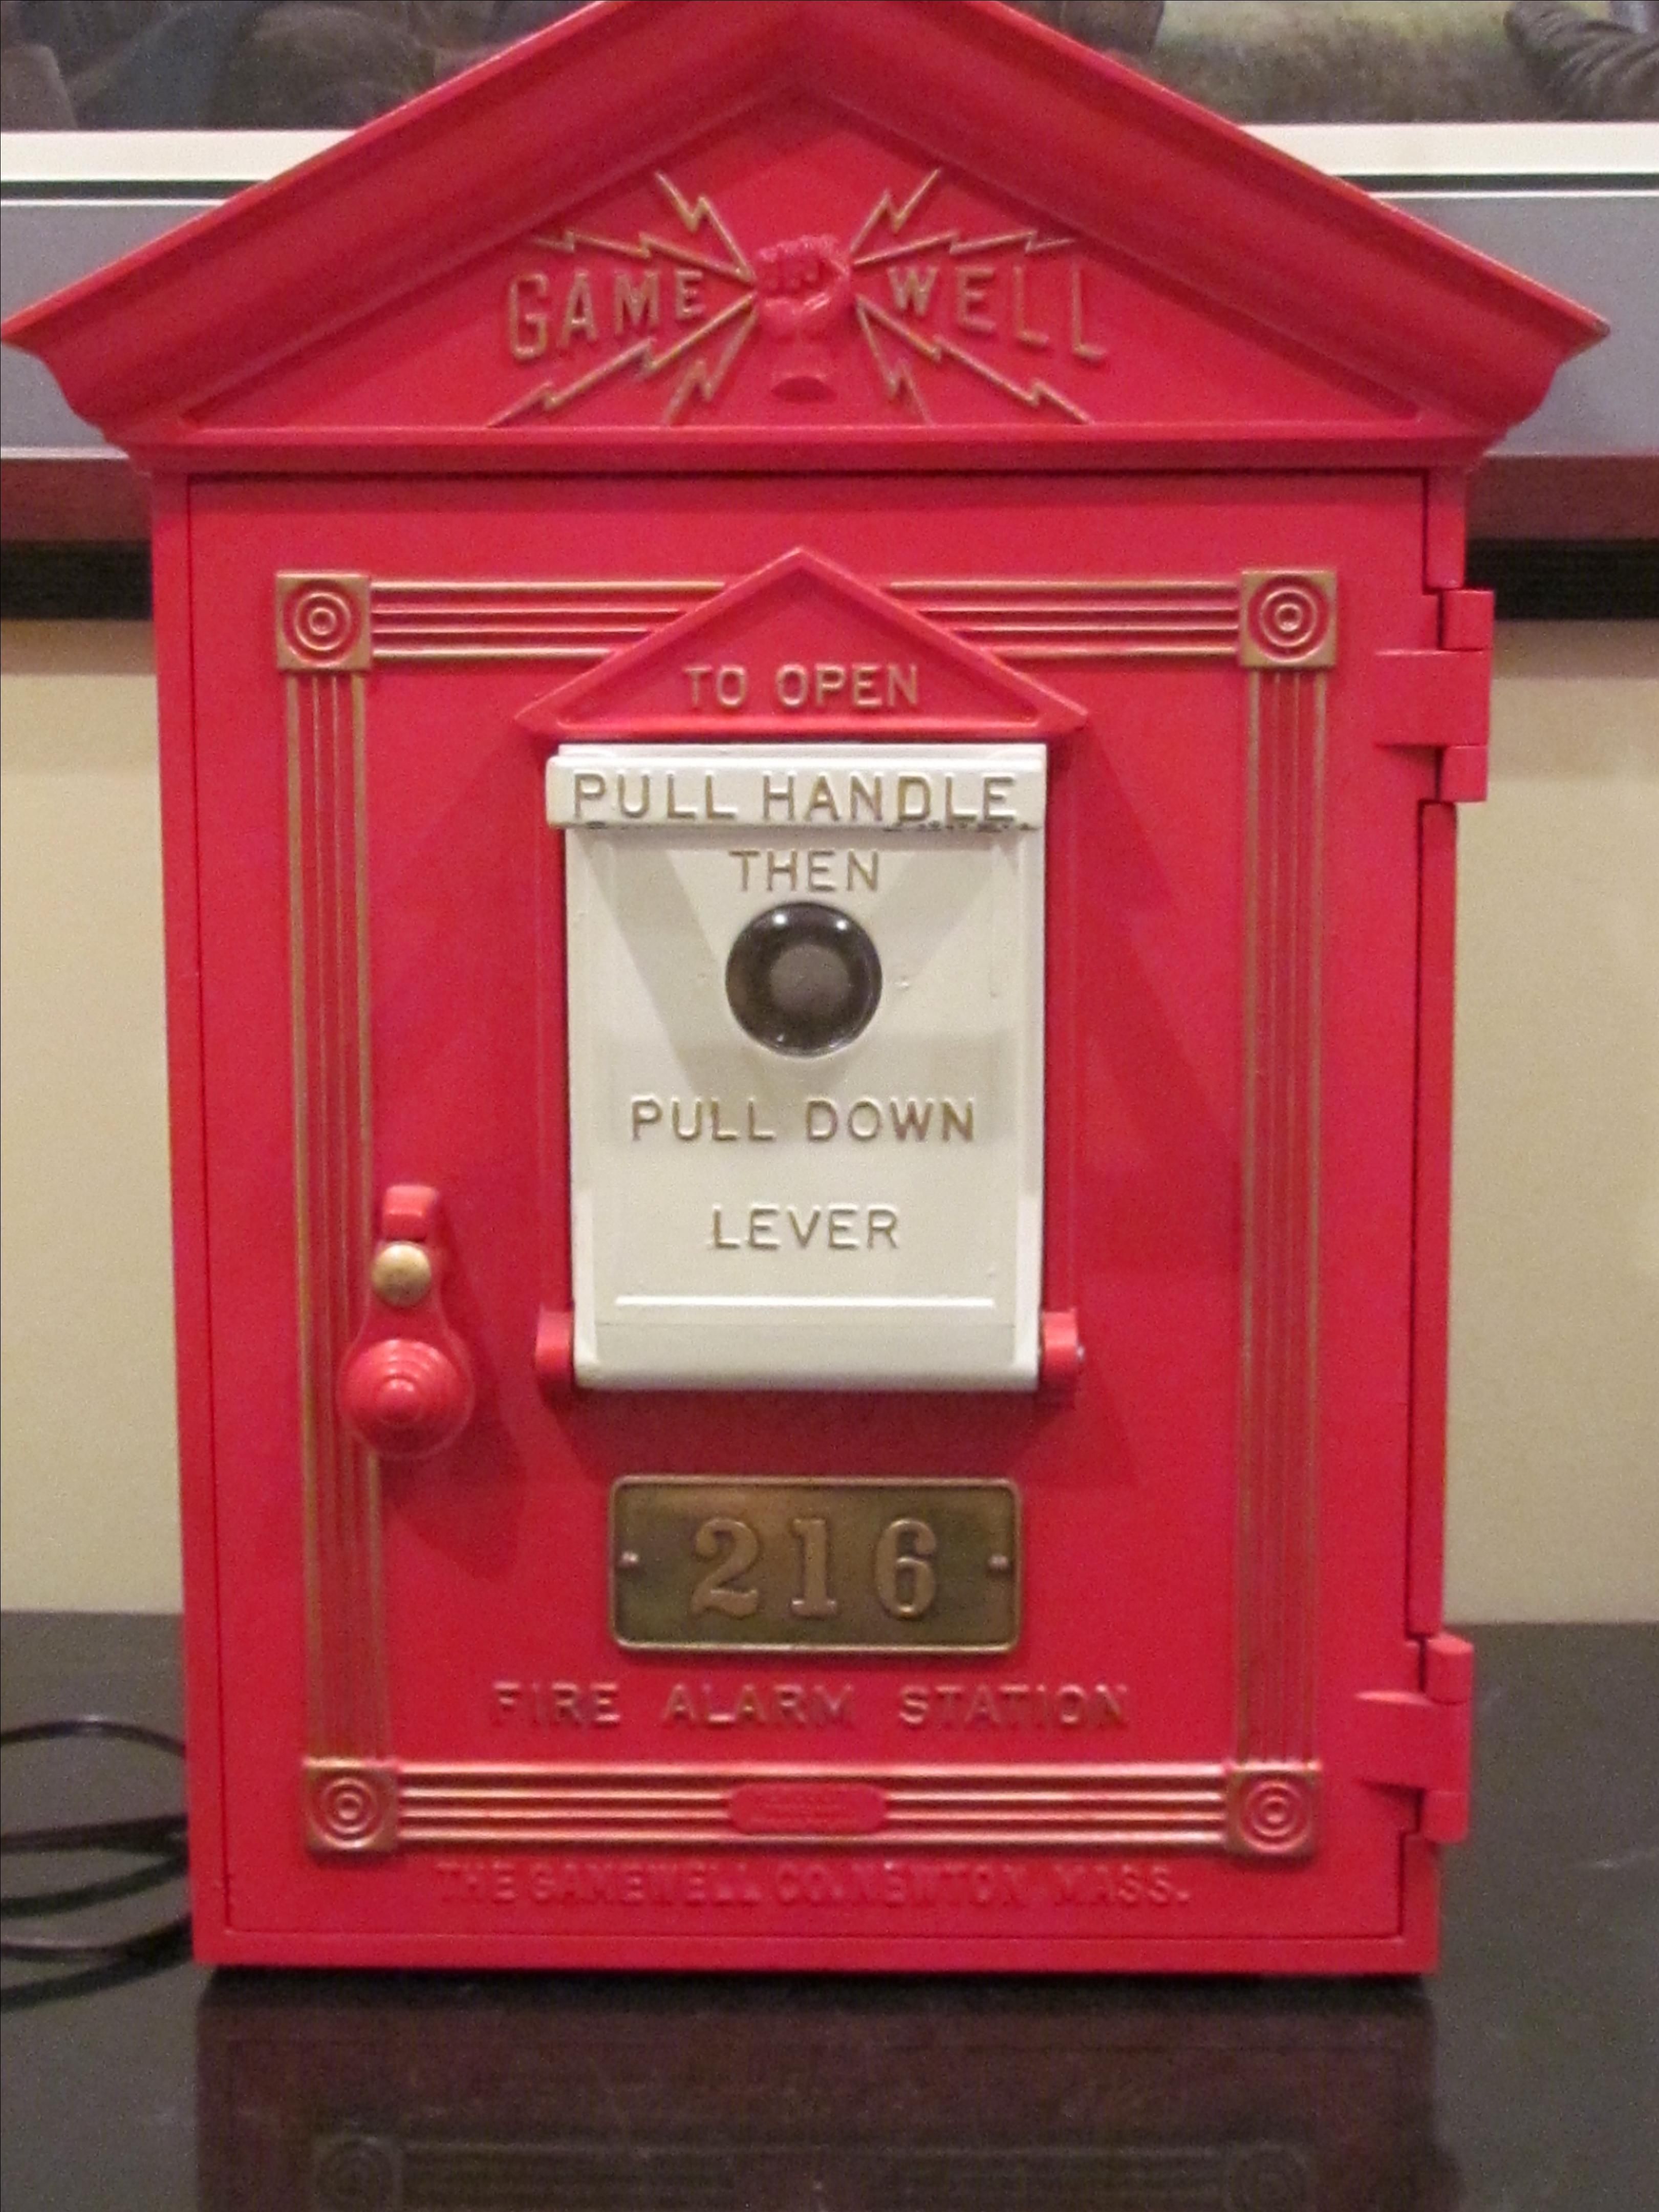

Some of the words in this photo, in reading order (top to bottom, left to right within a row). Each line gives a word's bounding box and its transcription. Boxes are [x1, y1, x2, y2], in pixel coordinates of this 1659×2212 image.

[507, 267, 707, 362] GAME
[888, 264, 1109, 362] WELL
[684, 663, 747, 708] TO
[776, 664, 918, 708] OPEN
[573, 774, 737, 820] PULL
[762, 776, 1017, 822] HANDLE
[729, 850, 879, 893] THEN
[631, 1096, 776, 1142] PULL
[805, 1096, 976, 1142] DOWN
[713, 1203, 900, 1250] LEVER
[691, 1516, 938, 1620] 216
[492, 1681, 621, 1727] FIRE
[660, 1682, 854, 1727] ALARM
[898, 1683, 1129, 1727] STATION
[435, 1861, 516, 1903] THE
[532, 1862, 762, 1905] GAMEWELL
